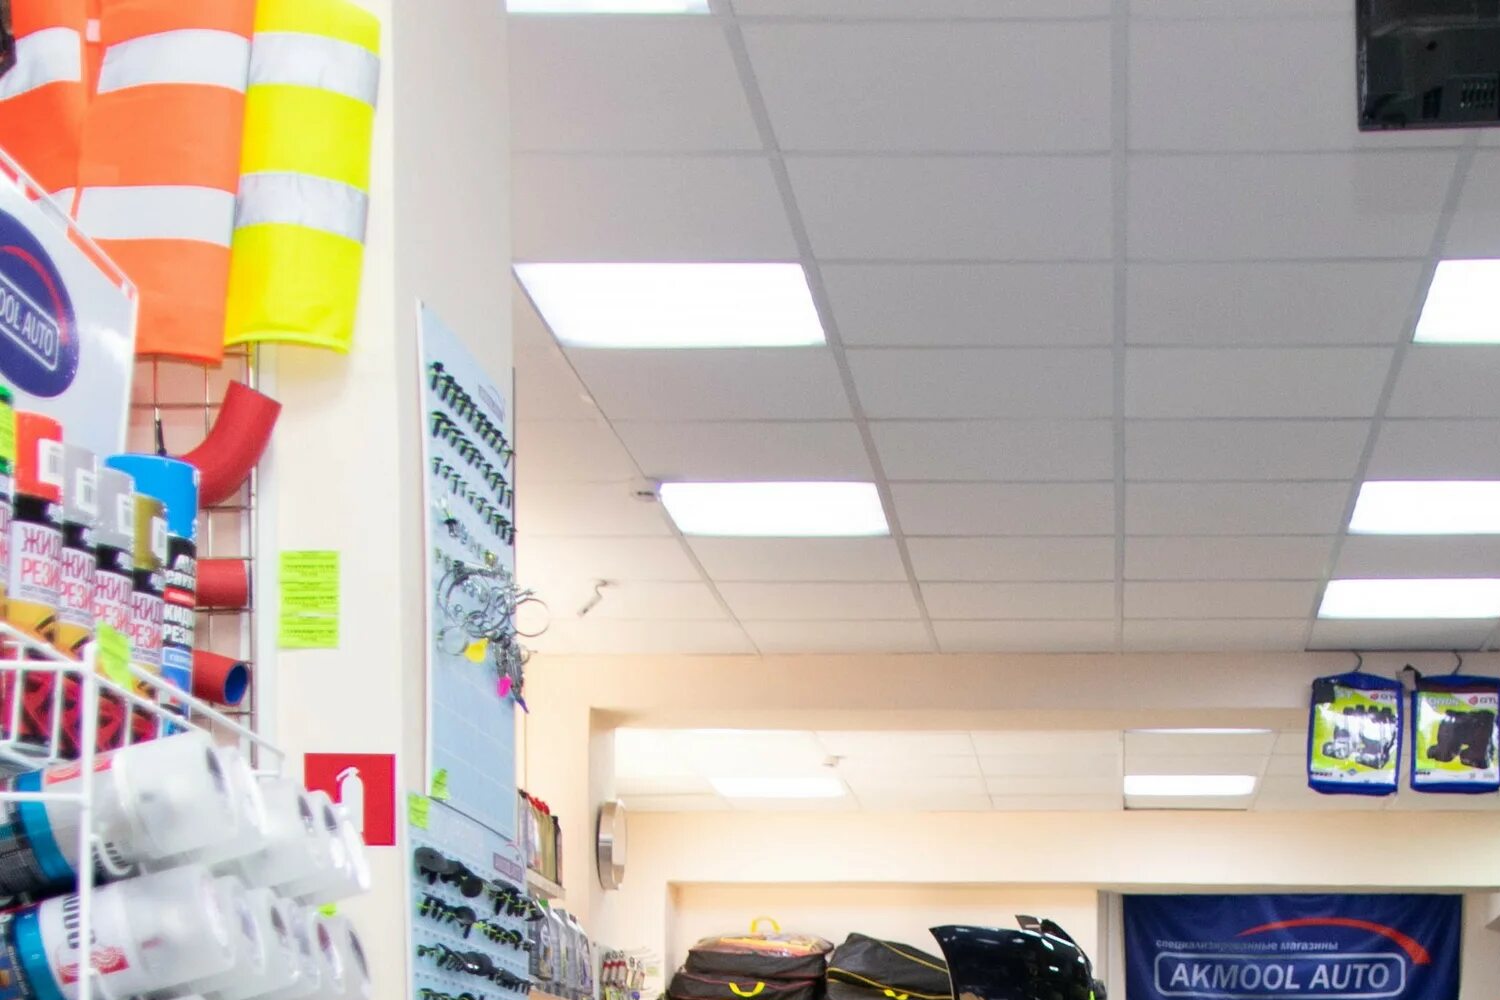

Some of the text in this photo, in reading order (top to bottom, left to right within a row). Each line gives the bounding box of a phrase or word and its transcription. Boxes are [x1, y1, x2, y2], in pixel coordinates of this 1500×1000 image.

[21, 312, 54, 357] AUTO
[1155, 939, 1338, 952] специализированные магазины
[1169, 962, 1390, 991] AKMOOL AUTO
